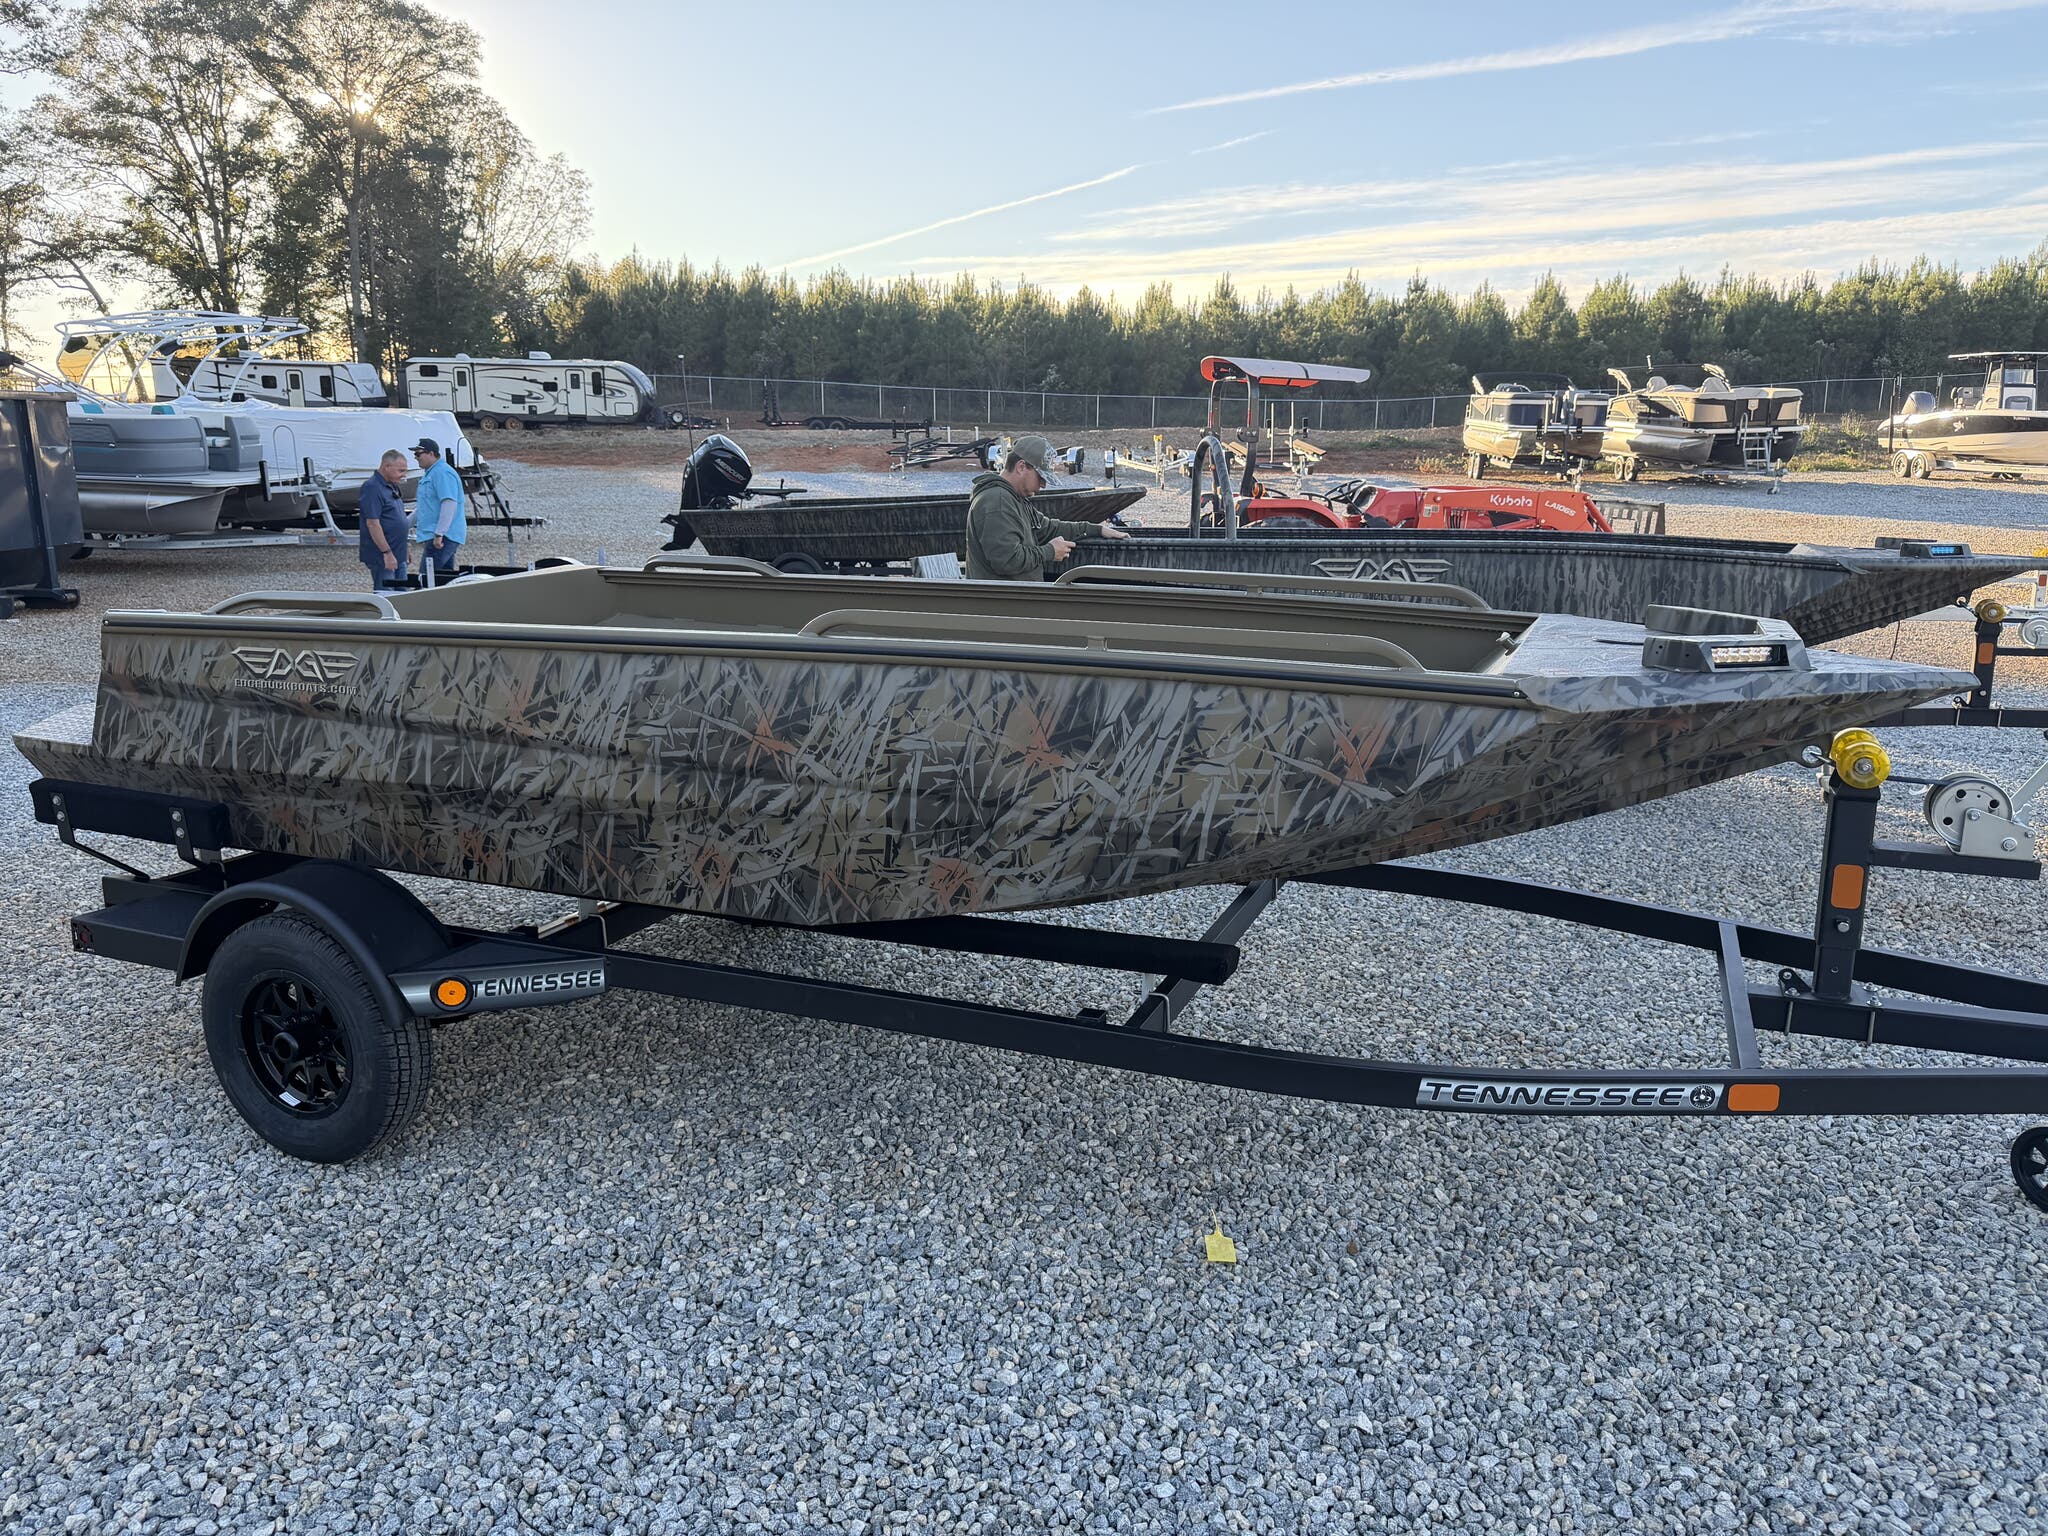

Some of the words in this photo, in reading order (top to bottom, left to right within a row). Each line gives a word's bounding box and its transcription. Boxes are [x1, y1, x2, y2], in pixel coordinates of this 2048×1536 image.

[1490, 494, 1533, 507] Kubota
[231, 646, 360, 682] EDGE
[234, 678, 357, 696] EDGEDUCKBOATS.COM
[472, 969, 602, 998] TENNESSEE
[1425, 1081, 1686, 1107] TENNESSEE
